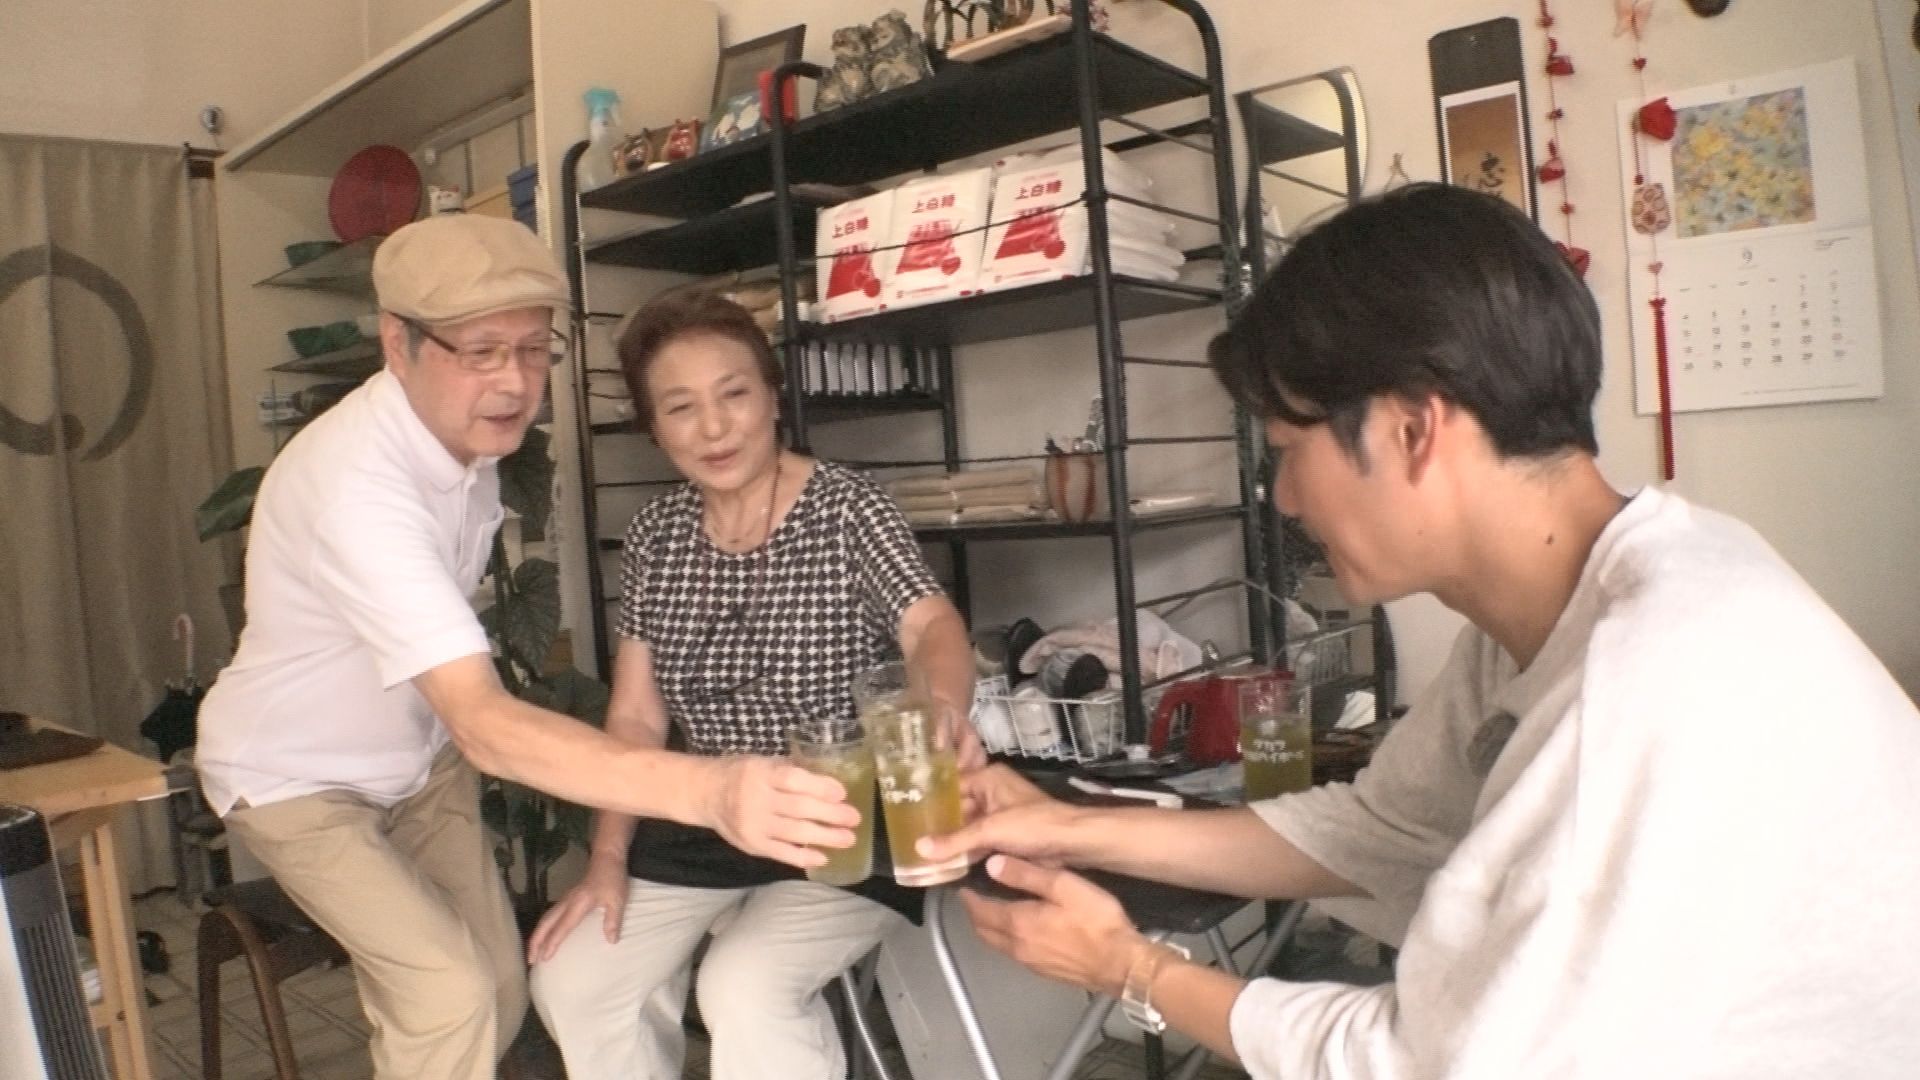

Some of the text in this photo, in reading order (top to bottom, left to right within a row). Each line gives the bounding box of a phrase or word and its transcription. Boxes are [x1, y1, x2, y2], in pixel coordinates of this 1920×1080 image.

[1015, 179, 1063, 201] 上白糖
[911, 193, 956, 214] 上白糖
[831, 216, 869, 240] 上白糖
